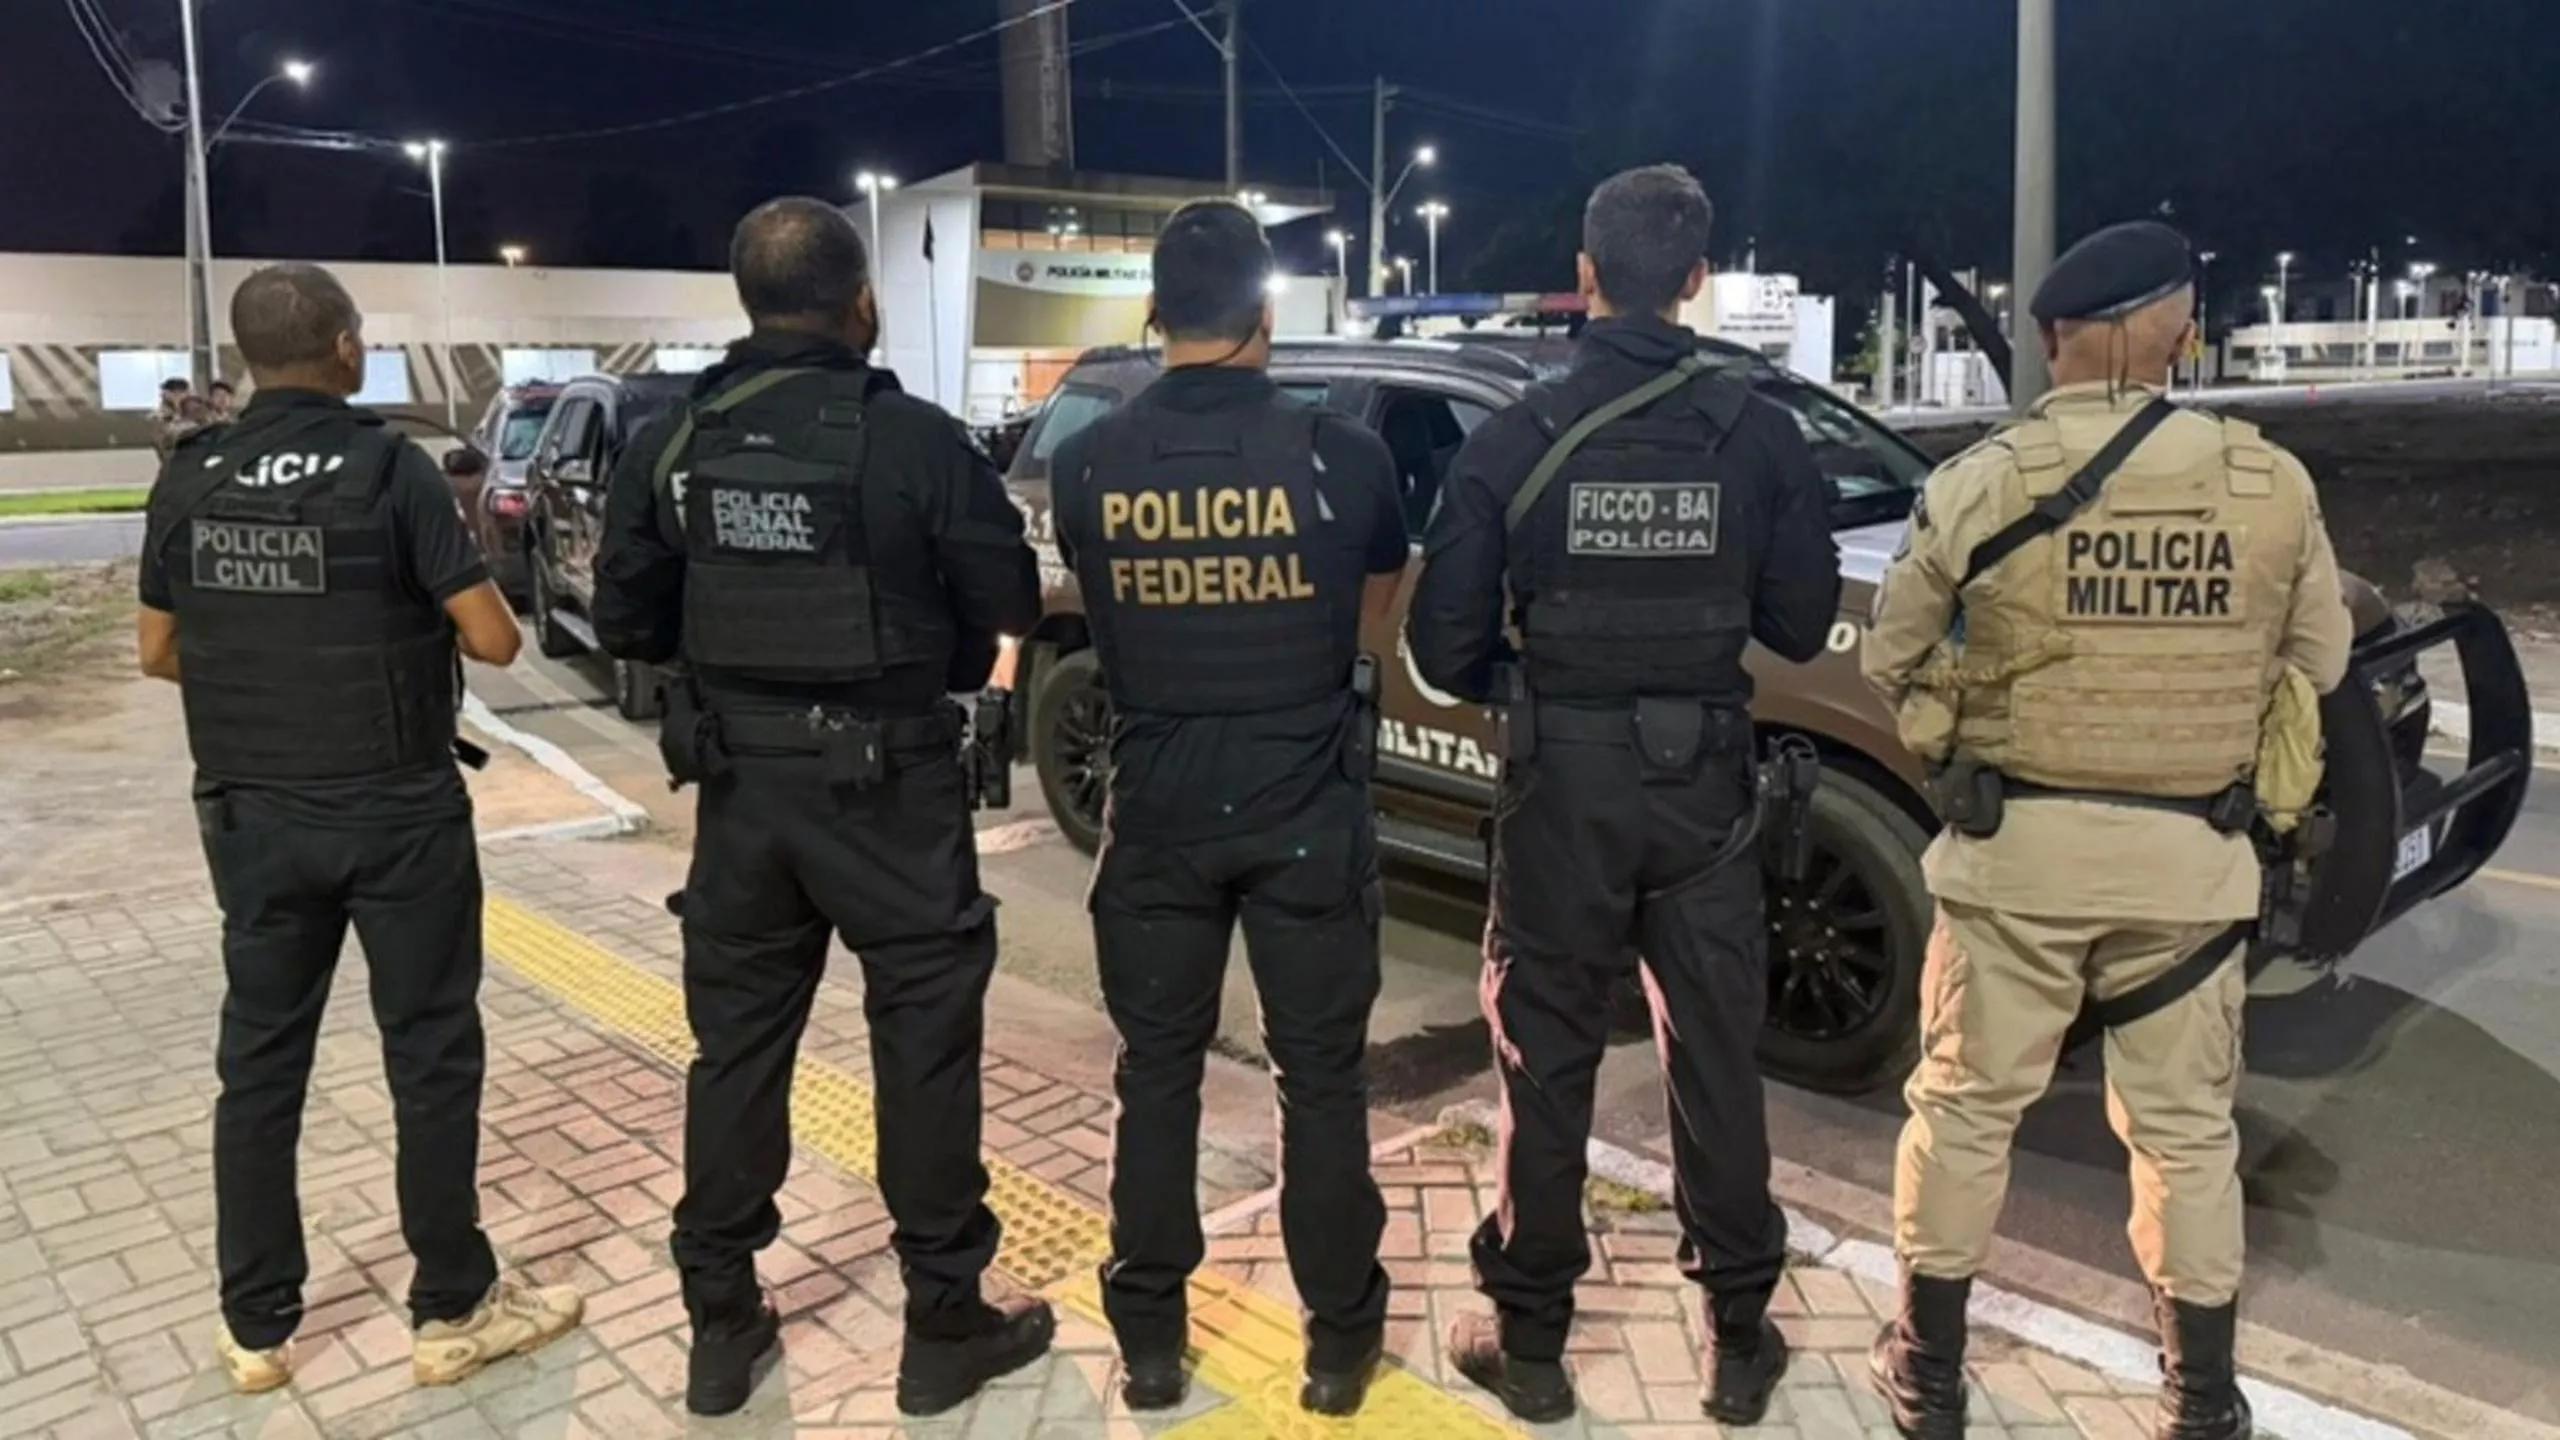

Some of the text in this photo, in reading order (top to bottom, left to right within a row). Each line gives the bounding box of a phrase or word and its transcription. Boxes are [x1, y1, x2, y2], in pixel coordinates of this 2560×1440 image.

[714, 508, 815, 533] PENAL
[1576, 489, 1655, 522] FICCO
[1676, 489, 1710, 521] BA
[717, 528, 815, 551] FEDERAL
[2067, 526, 2233, 571] POLÍCIA
[215, 558, 301, 587] CIVIL
[1109, 553, 1315, 604] FEDERAL
[2067, 576, 2231, 616] MILITAR
[1377, 718, 1499, 778] ILITA
